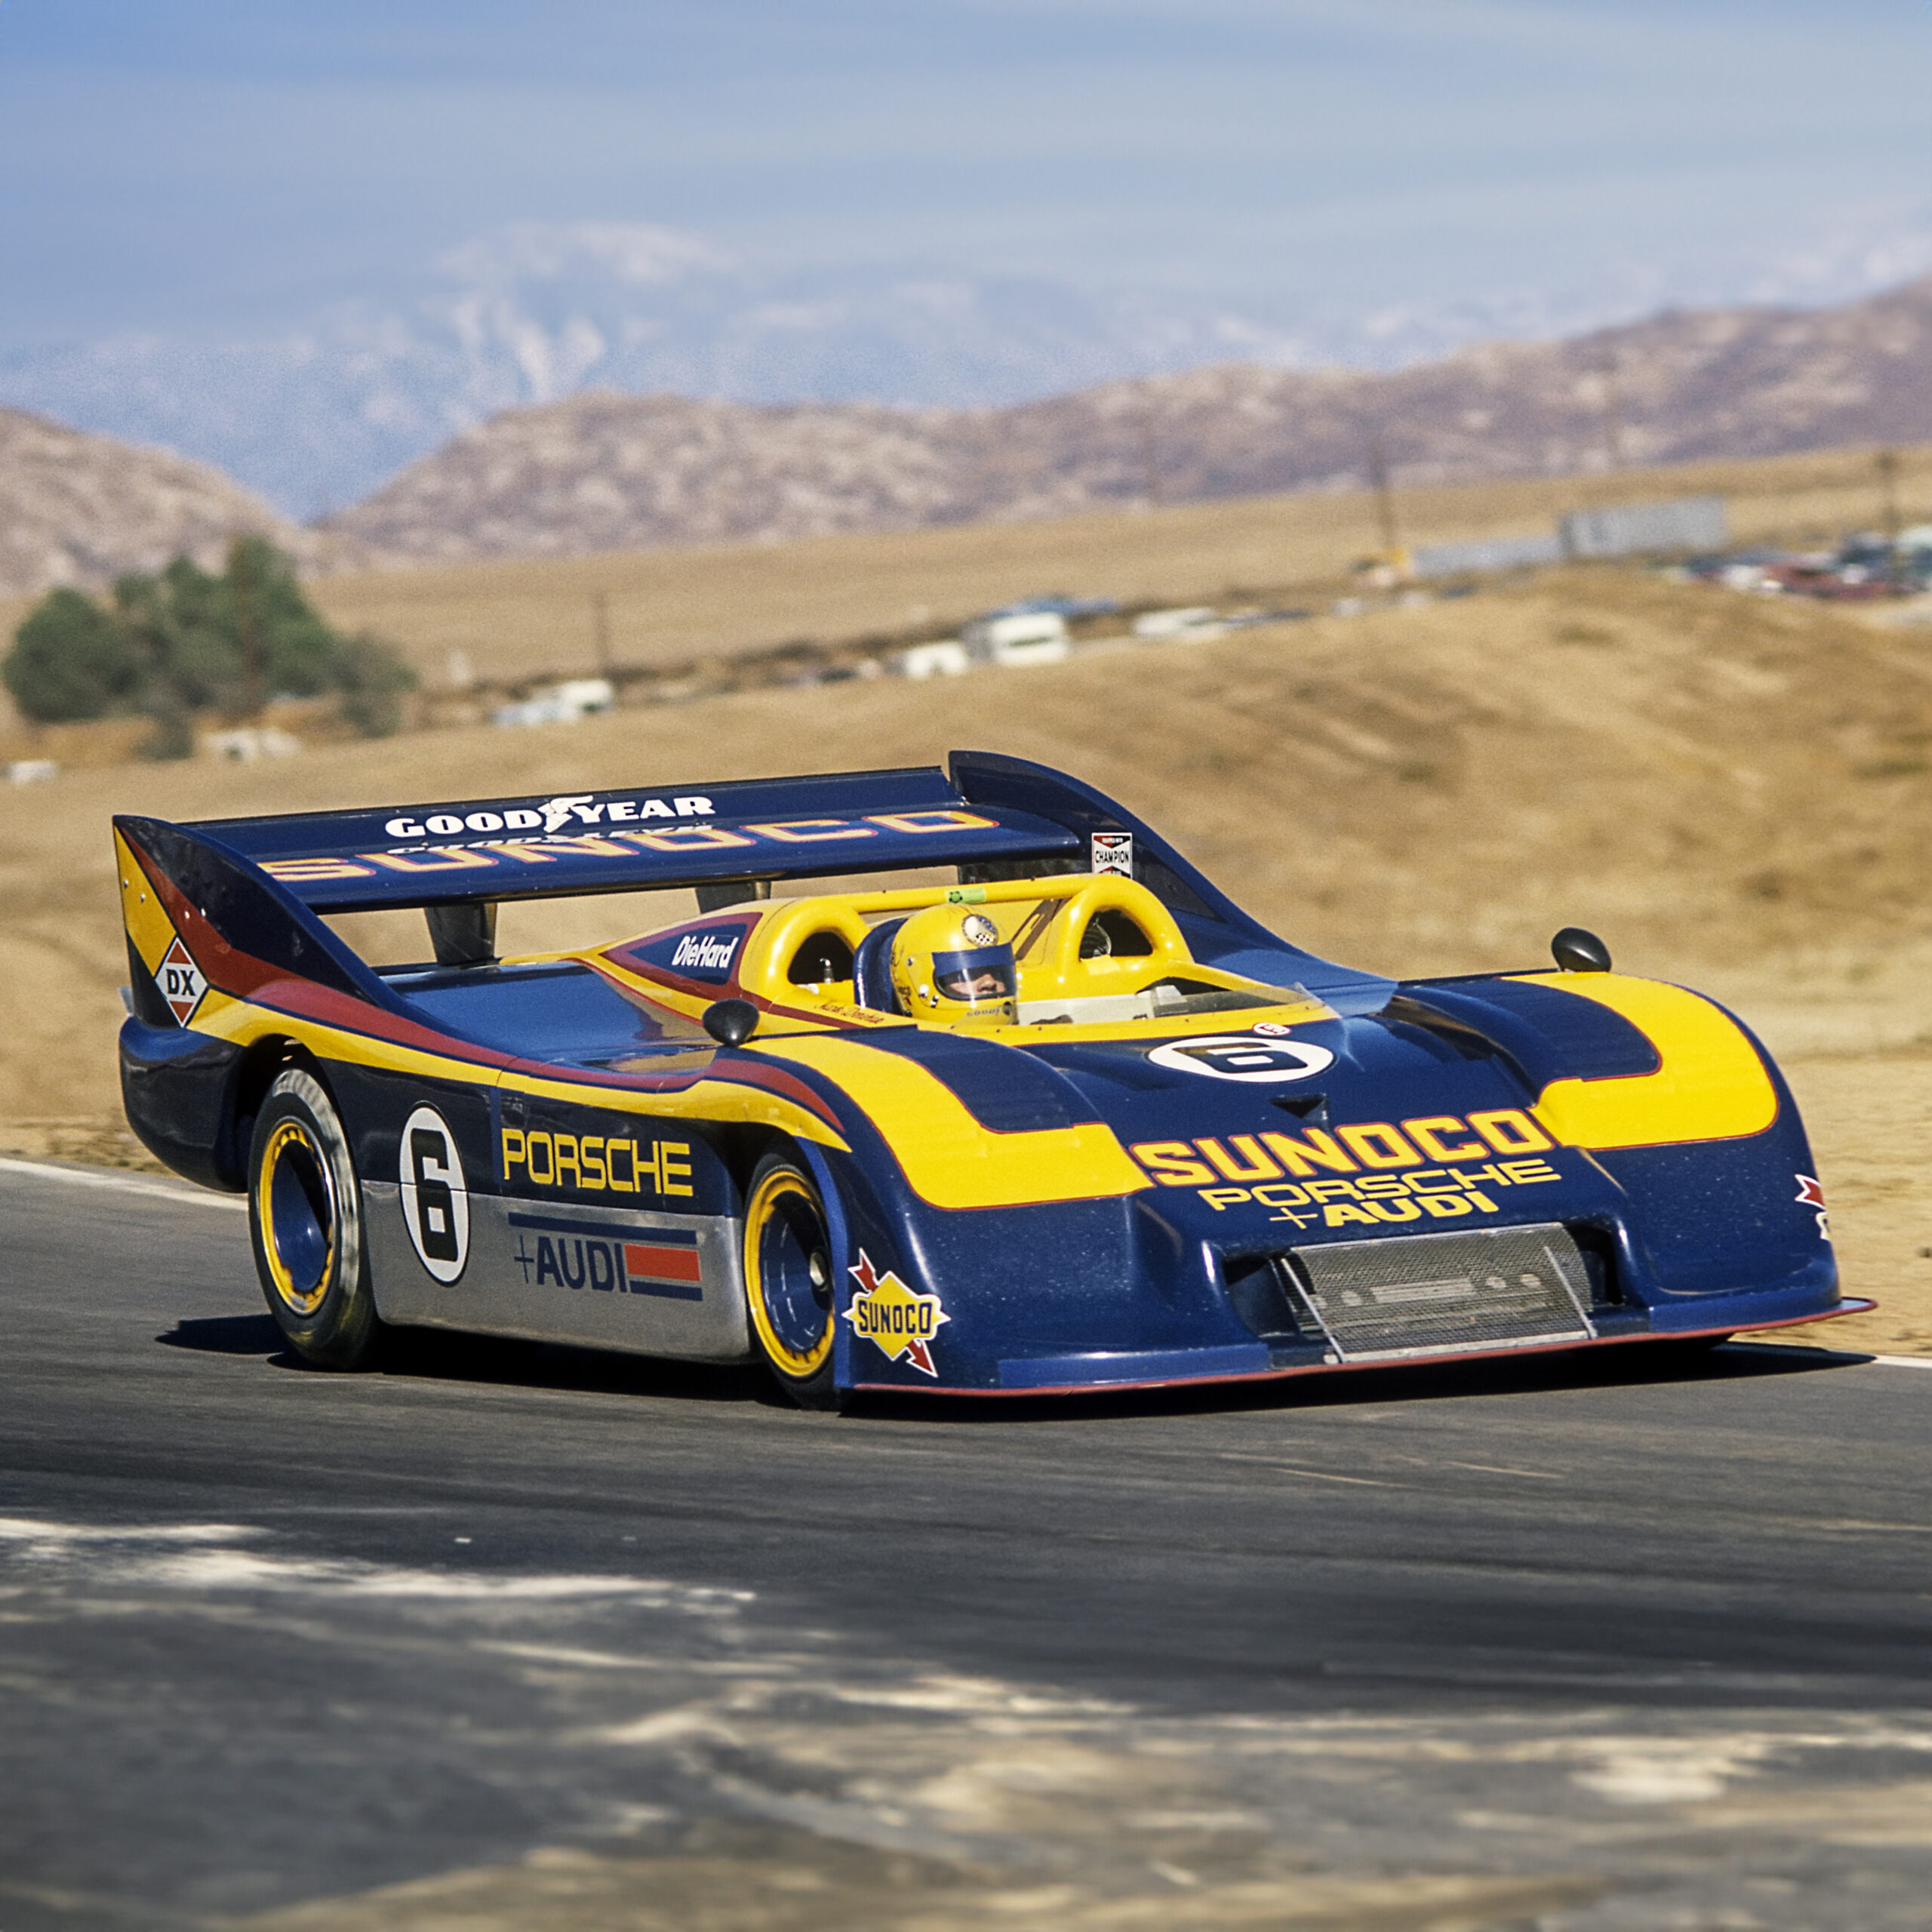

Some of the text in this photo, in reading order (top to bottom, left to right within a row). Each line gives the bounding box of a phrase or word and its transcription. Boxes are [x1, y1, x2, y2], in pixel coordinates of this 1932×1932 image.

[257, 810, 1000, 881] SUNOCO
[1095, 851, 1130, 863] CHAMPION
[672, 936, 739, 968] DieHard
[166, 969, 195, 996] DX
[1172, 1041, 1309, 1074] 6
[501, 1128, 694, 1197] PORSCHE
[1128, 1107, 1556, 1187] SUNOCO
[411, 1128, 459, 1263] 6
[1197, 1158, 1561, 1211] PORSCHE
[858, 1300, 933, 1334] SUNOCO
